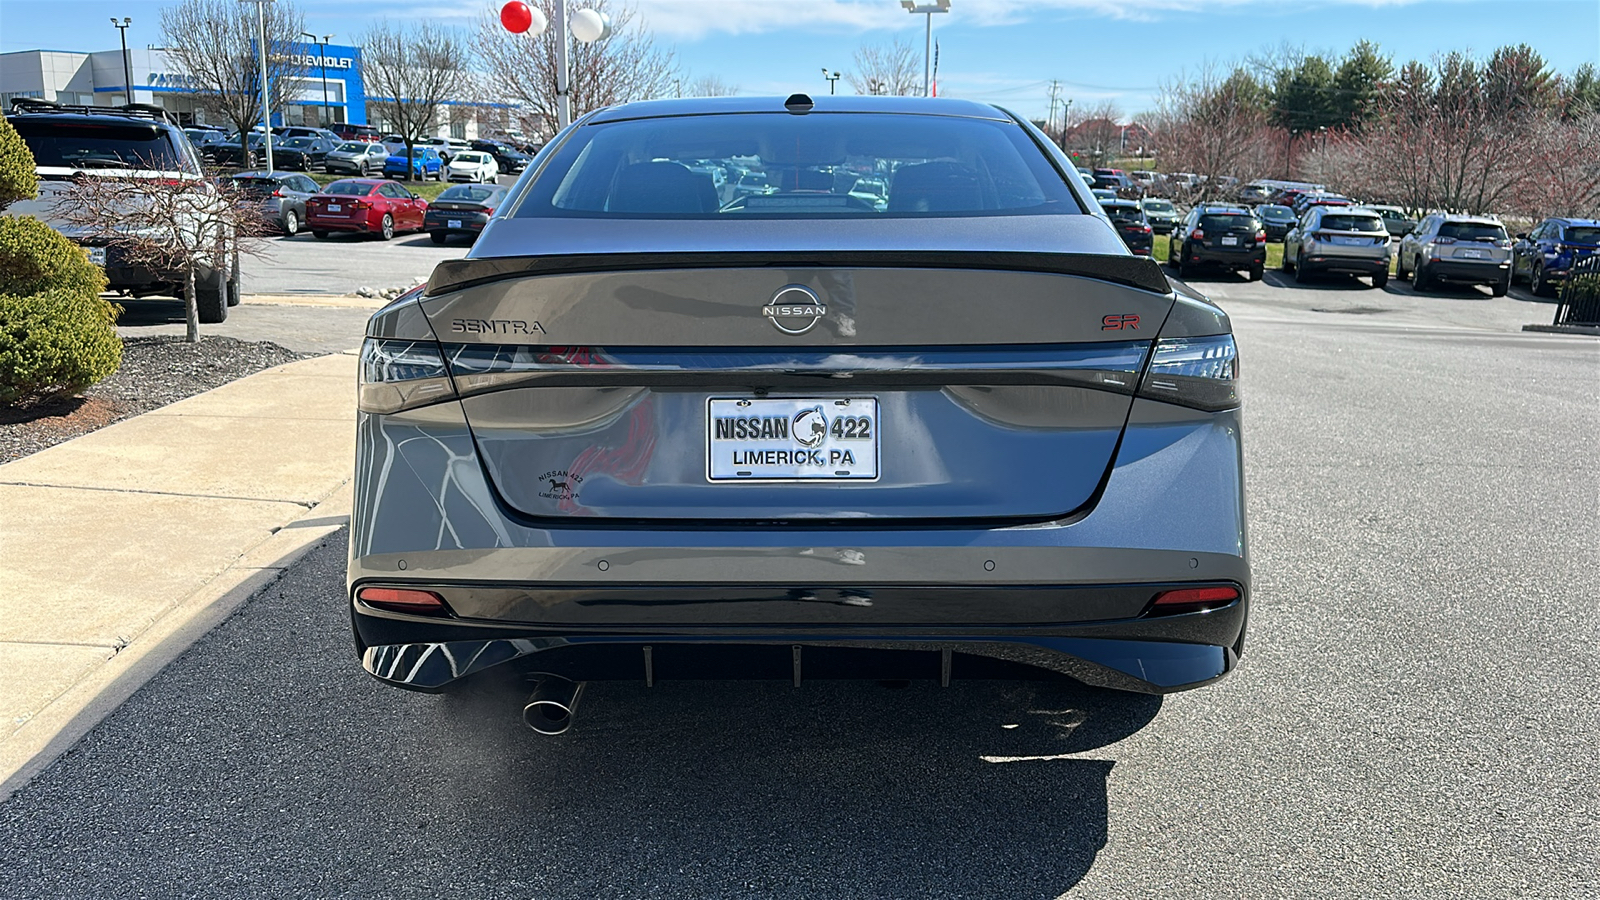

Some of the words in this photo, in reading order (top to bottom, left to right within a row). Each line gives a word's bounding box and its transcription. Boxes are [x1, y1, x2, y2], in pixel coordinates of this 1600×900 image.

[148, 72, 200, 87] PATRIO
[764, 307, 826, 315] NISSAN
[452, 318, 547, 335] SENTRA
[1101, 314, 1140, 331] SR
[715, 417, 789, 440] NISSAN
[830, 416, 872, 440] 422
[733, 450, 825, 467] LIMERICK,
[830, 450, 854, 465] PA
[538, 470, 568, 482] NISSAN
[570, 472, 584, 484] 422
